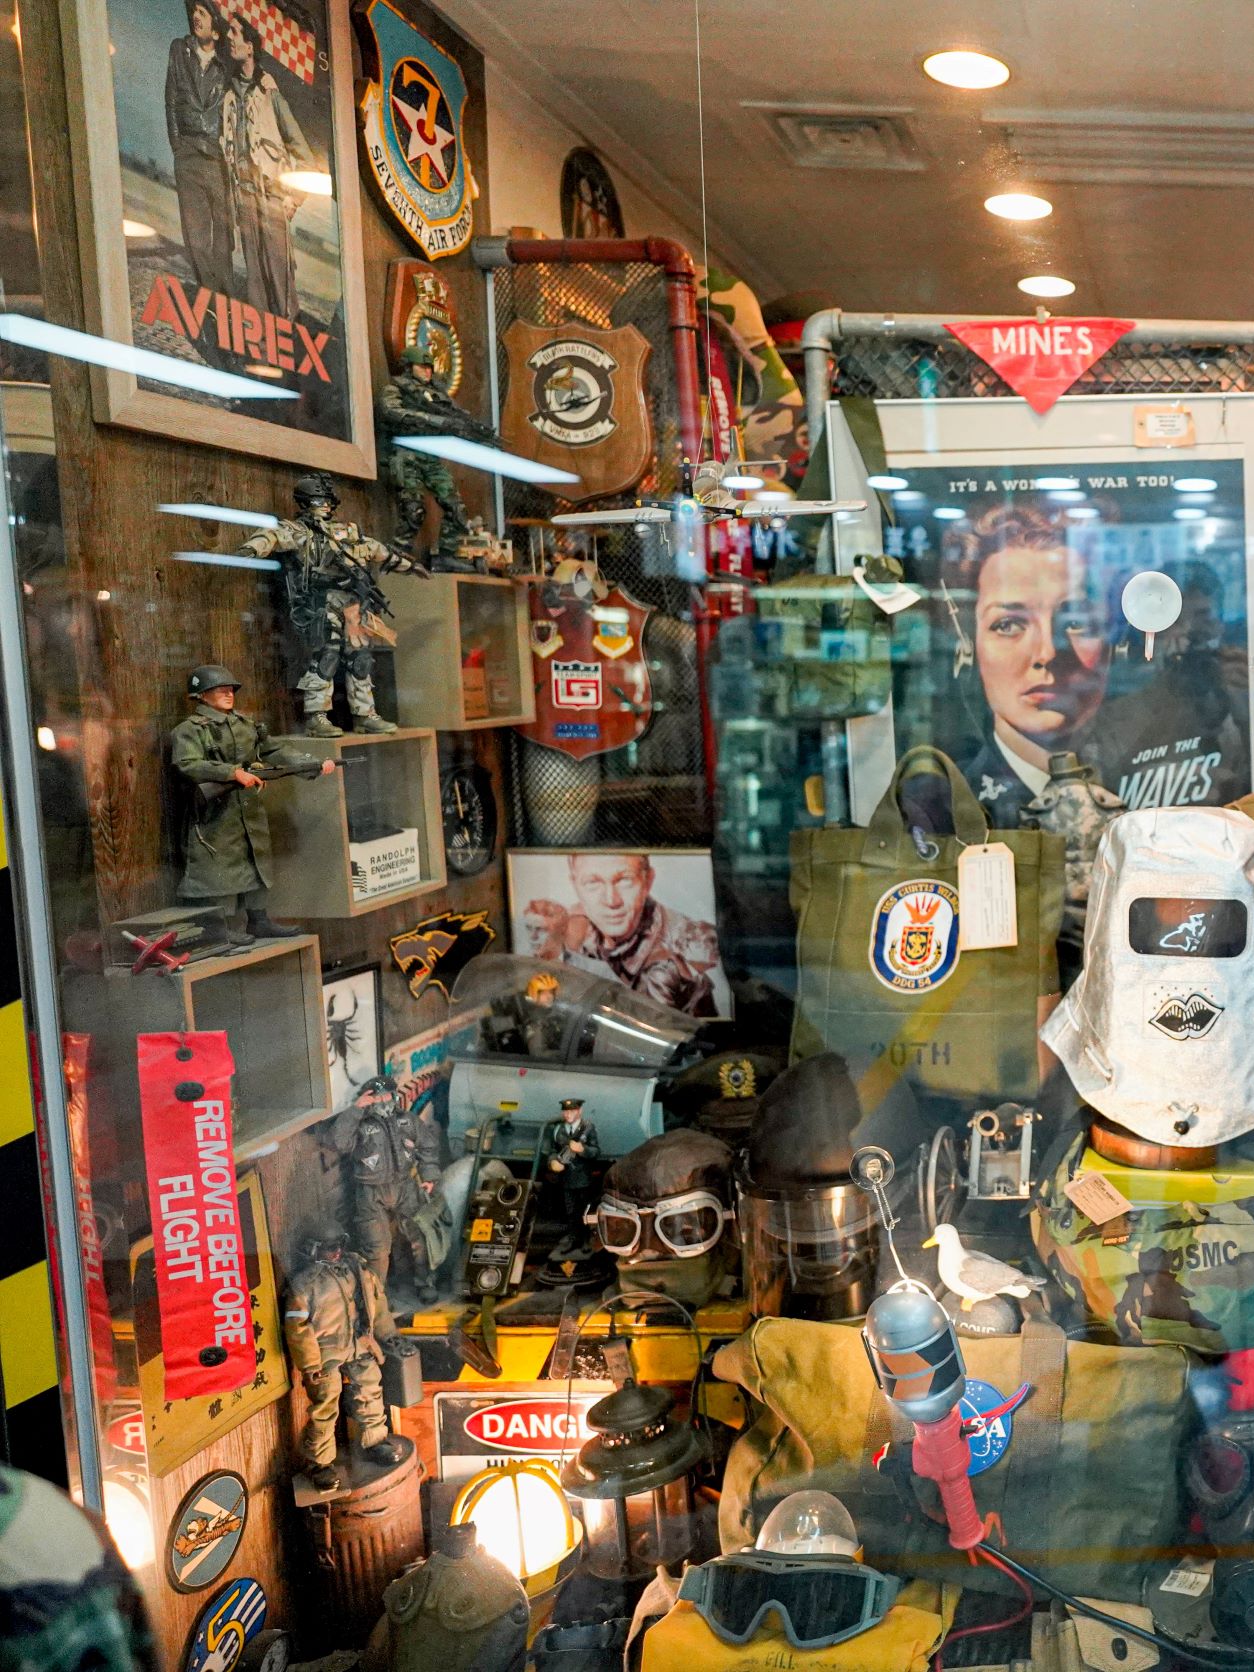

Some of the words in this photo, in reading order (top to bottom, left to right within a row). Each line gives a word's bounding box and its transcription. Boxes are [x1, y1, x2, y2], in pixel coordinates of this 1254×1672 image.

[369, 145, 424, 238] SEVENTH
[427, 227, 449, 251] AIR
[141, 273, 332, 383] AVIREX
[992, 325, 1094, 356] MINES
[949, 478, 978, 493] IT'S
[984, 480, 997, 491] A
[1087, 476, 1129, 489] WAR
[1136, 475, 1175, 488] TOO!
[1132, 745, 1168, 765] JOIN
[1175, 736, 1202, 753] THE
[1118, 752, 1222, 811] WAVES
[370, 847, 415, 865] RANDOLPH
[371, 855, 416, 875] ENGINEERING
[881, 895, 899, 914] USS
[898, 883, 936, 897] CURTIS
[892, 977, 915, 988] DDG
[918, 977, 932, 988] 54
[193, 1100, 235, 1228] REMOVE
[158, 1174, 203, 1283] FLIGHT
[1169, 1240, 1239, 1272] USMC
[207, 1234, 247, 1348] BEFORE
[482, 1413, 597, 1439] DANG
[968, 1417, 1007, 1438] SA
